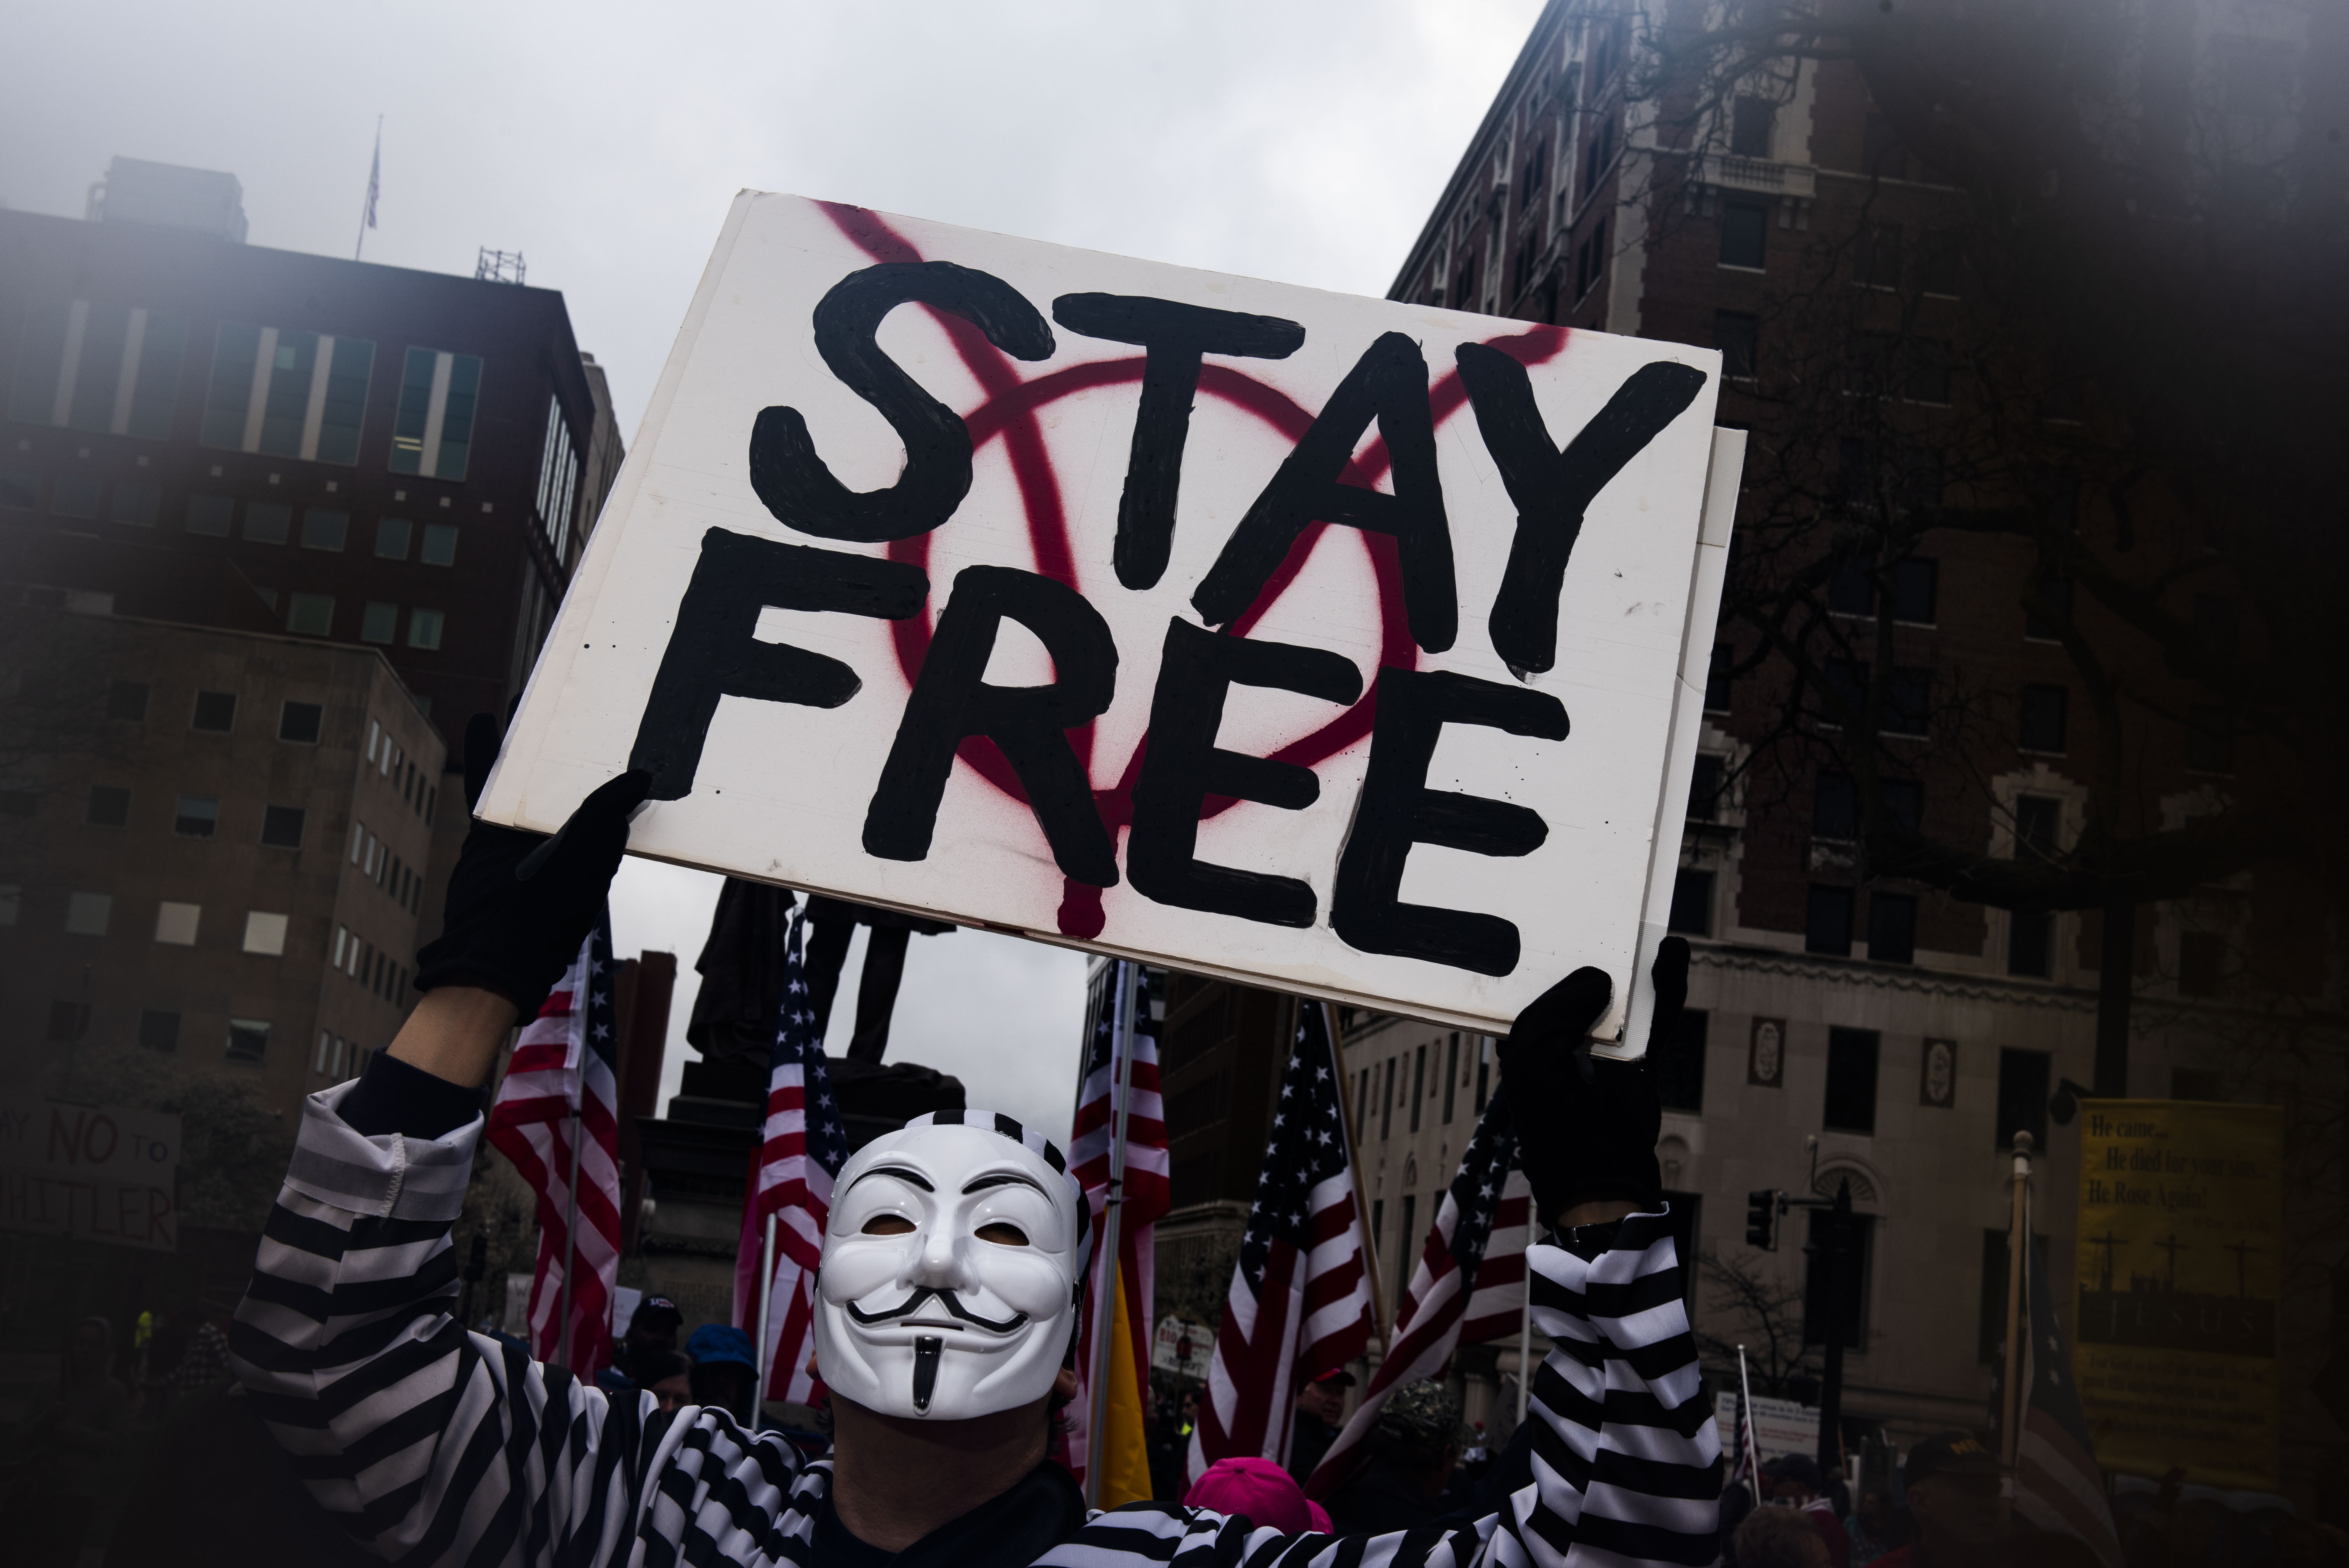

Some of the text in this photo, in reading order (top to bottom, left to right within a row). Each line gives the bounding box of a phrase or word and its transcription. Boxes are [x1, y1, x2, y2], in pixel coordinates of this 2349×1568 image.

[749, 260, 1707, 675] STAY
[629, 526, 1570, 976] FREE
[46, 1108, 119, 1165] NO
[2092, 1115, 2112, 1137] He
[2107, 1147, 2126, 1171] He
[2130, 1147, 2161, 1172] died
[2166, 1149, 2187, 1173] for
[0, 1172, 173, 1245] HITLER
[2089, 1180, 2109, 1204] He
[2115, 1181, 2152, 1206] Rose
[2107, 1298, 2256, 1338] JESUS
